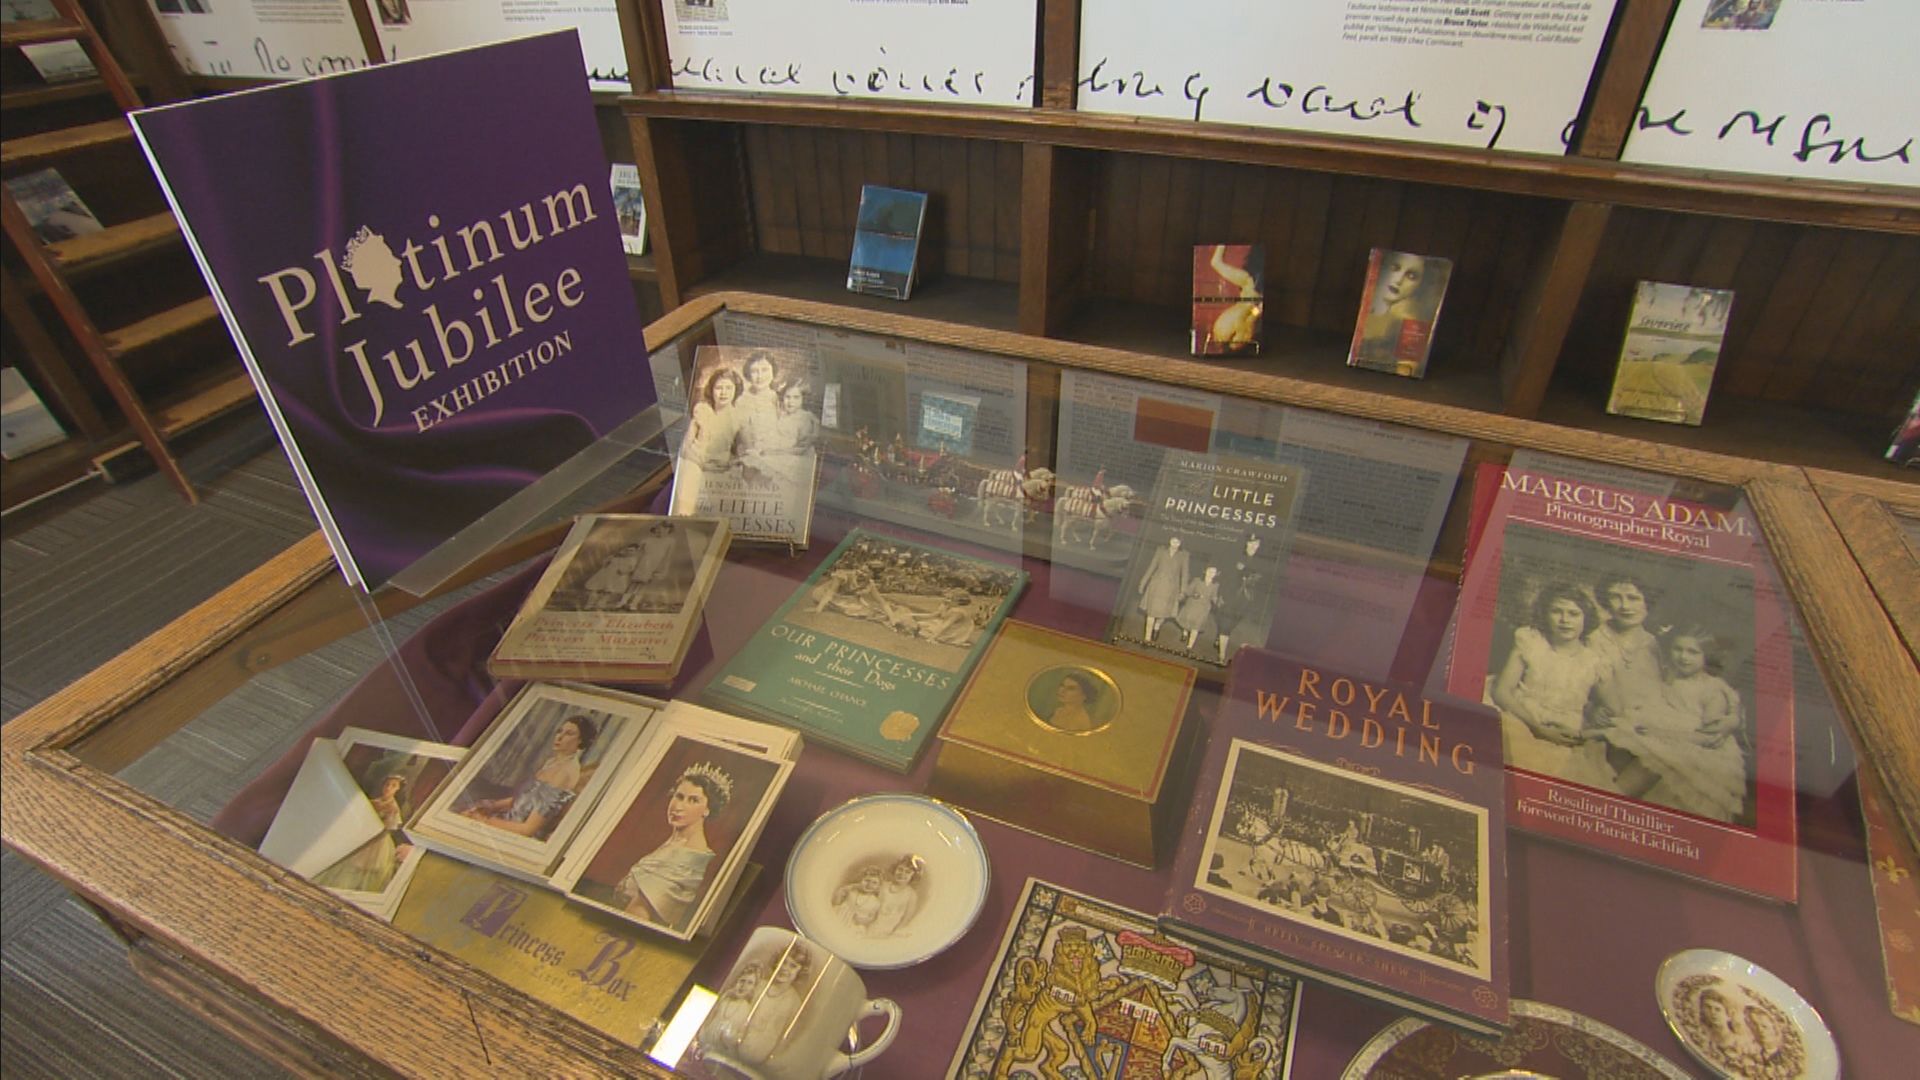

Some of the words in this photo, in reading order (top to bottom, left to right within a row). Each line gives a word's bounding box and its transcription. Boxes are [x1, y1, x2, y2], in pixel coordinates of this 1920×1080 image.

[258, 183, 598, 347] Pltinum
[344, 265, 586, 427] Jubilee
[411, 330, 573, 432] EXHIBITION
[1180, 459, 1223, 473] MARION
[1226, 466, 1288, 483] CRAWFORD
[1500, 471, 1635, 516] MARCUS
[719, 499, 784, 516] LITTLE
[1164, 497, 1277, 528] PRINCESSES
[1212, 484, 1275, 506] LITTLE
[1545, 503, 1659, 538] Photographer
[1661, 526, 1711, 549] Royal
[770, 624, 816, 648] OUR
[824, 640, 951, 690] PRINCESSES
[794, 652, 821, 665] and
[826, 659, 854, 677] their
[864, 668, 897, 692] Dogs
[1298, 668, 1441, 730] ROYAL
[1256, 689, 1475, 775] WEDDING
[1548, 789, 1608, 815] Rosalind
[1516, 800, 1576, 826] Foreword
[1577, 814, 1592, 833] by
[1595, 820, 1640, 846] Patrick
[1641, 832, 1700, 860] Lichfield
